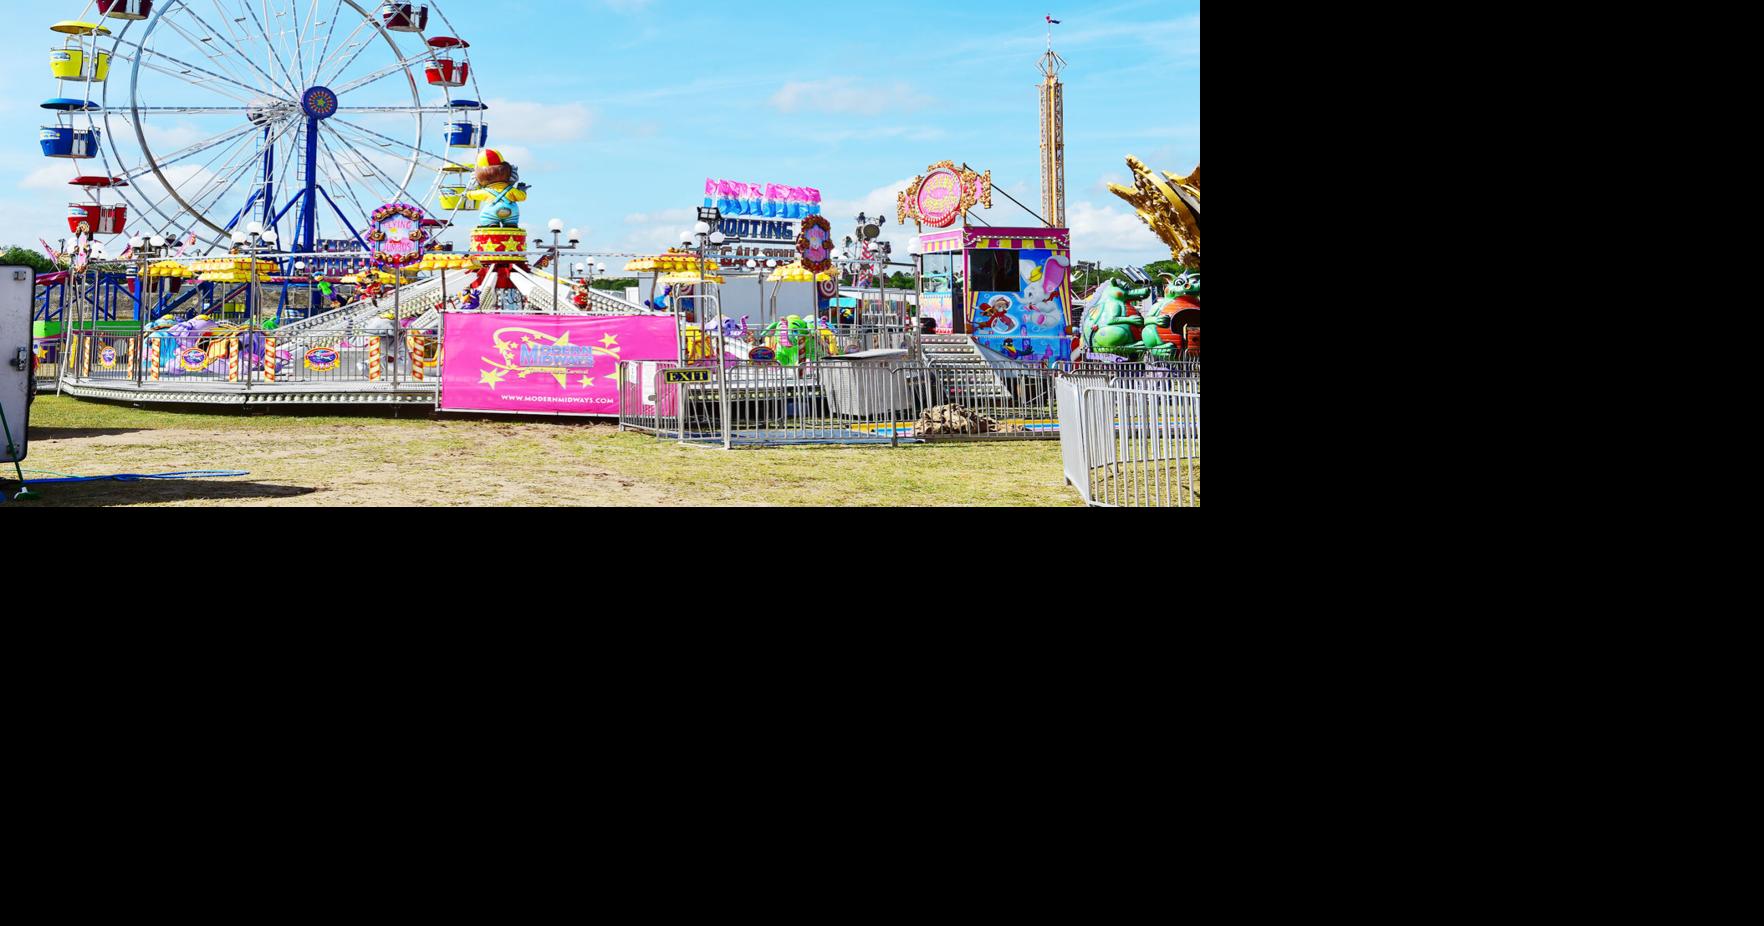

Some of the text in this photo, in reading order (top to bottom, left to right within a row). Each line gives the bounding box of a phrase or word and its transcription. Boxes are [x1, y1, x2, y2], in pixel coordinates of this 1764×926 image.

[383, 219, 412, 230] FLYING
[718, 217, 793, 240] OOTING
[520, 343, 593, 366] MODERN
[670, 371, 707, 381] EXIT
[501, 394, 614, 404] WWW.MODERNMIDWAYS.COM
